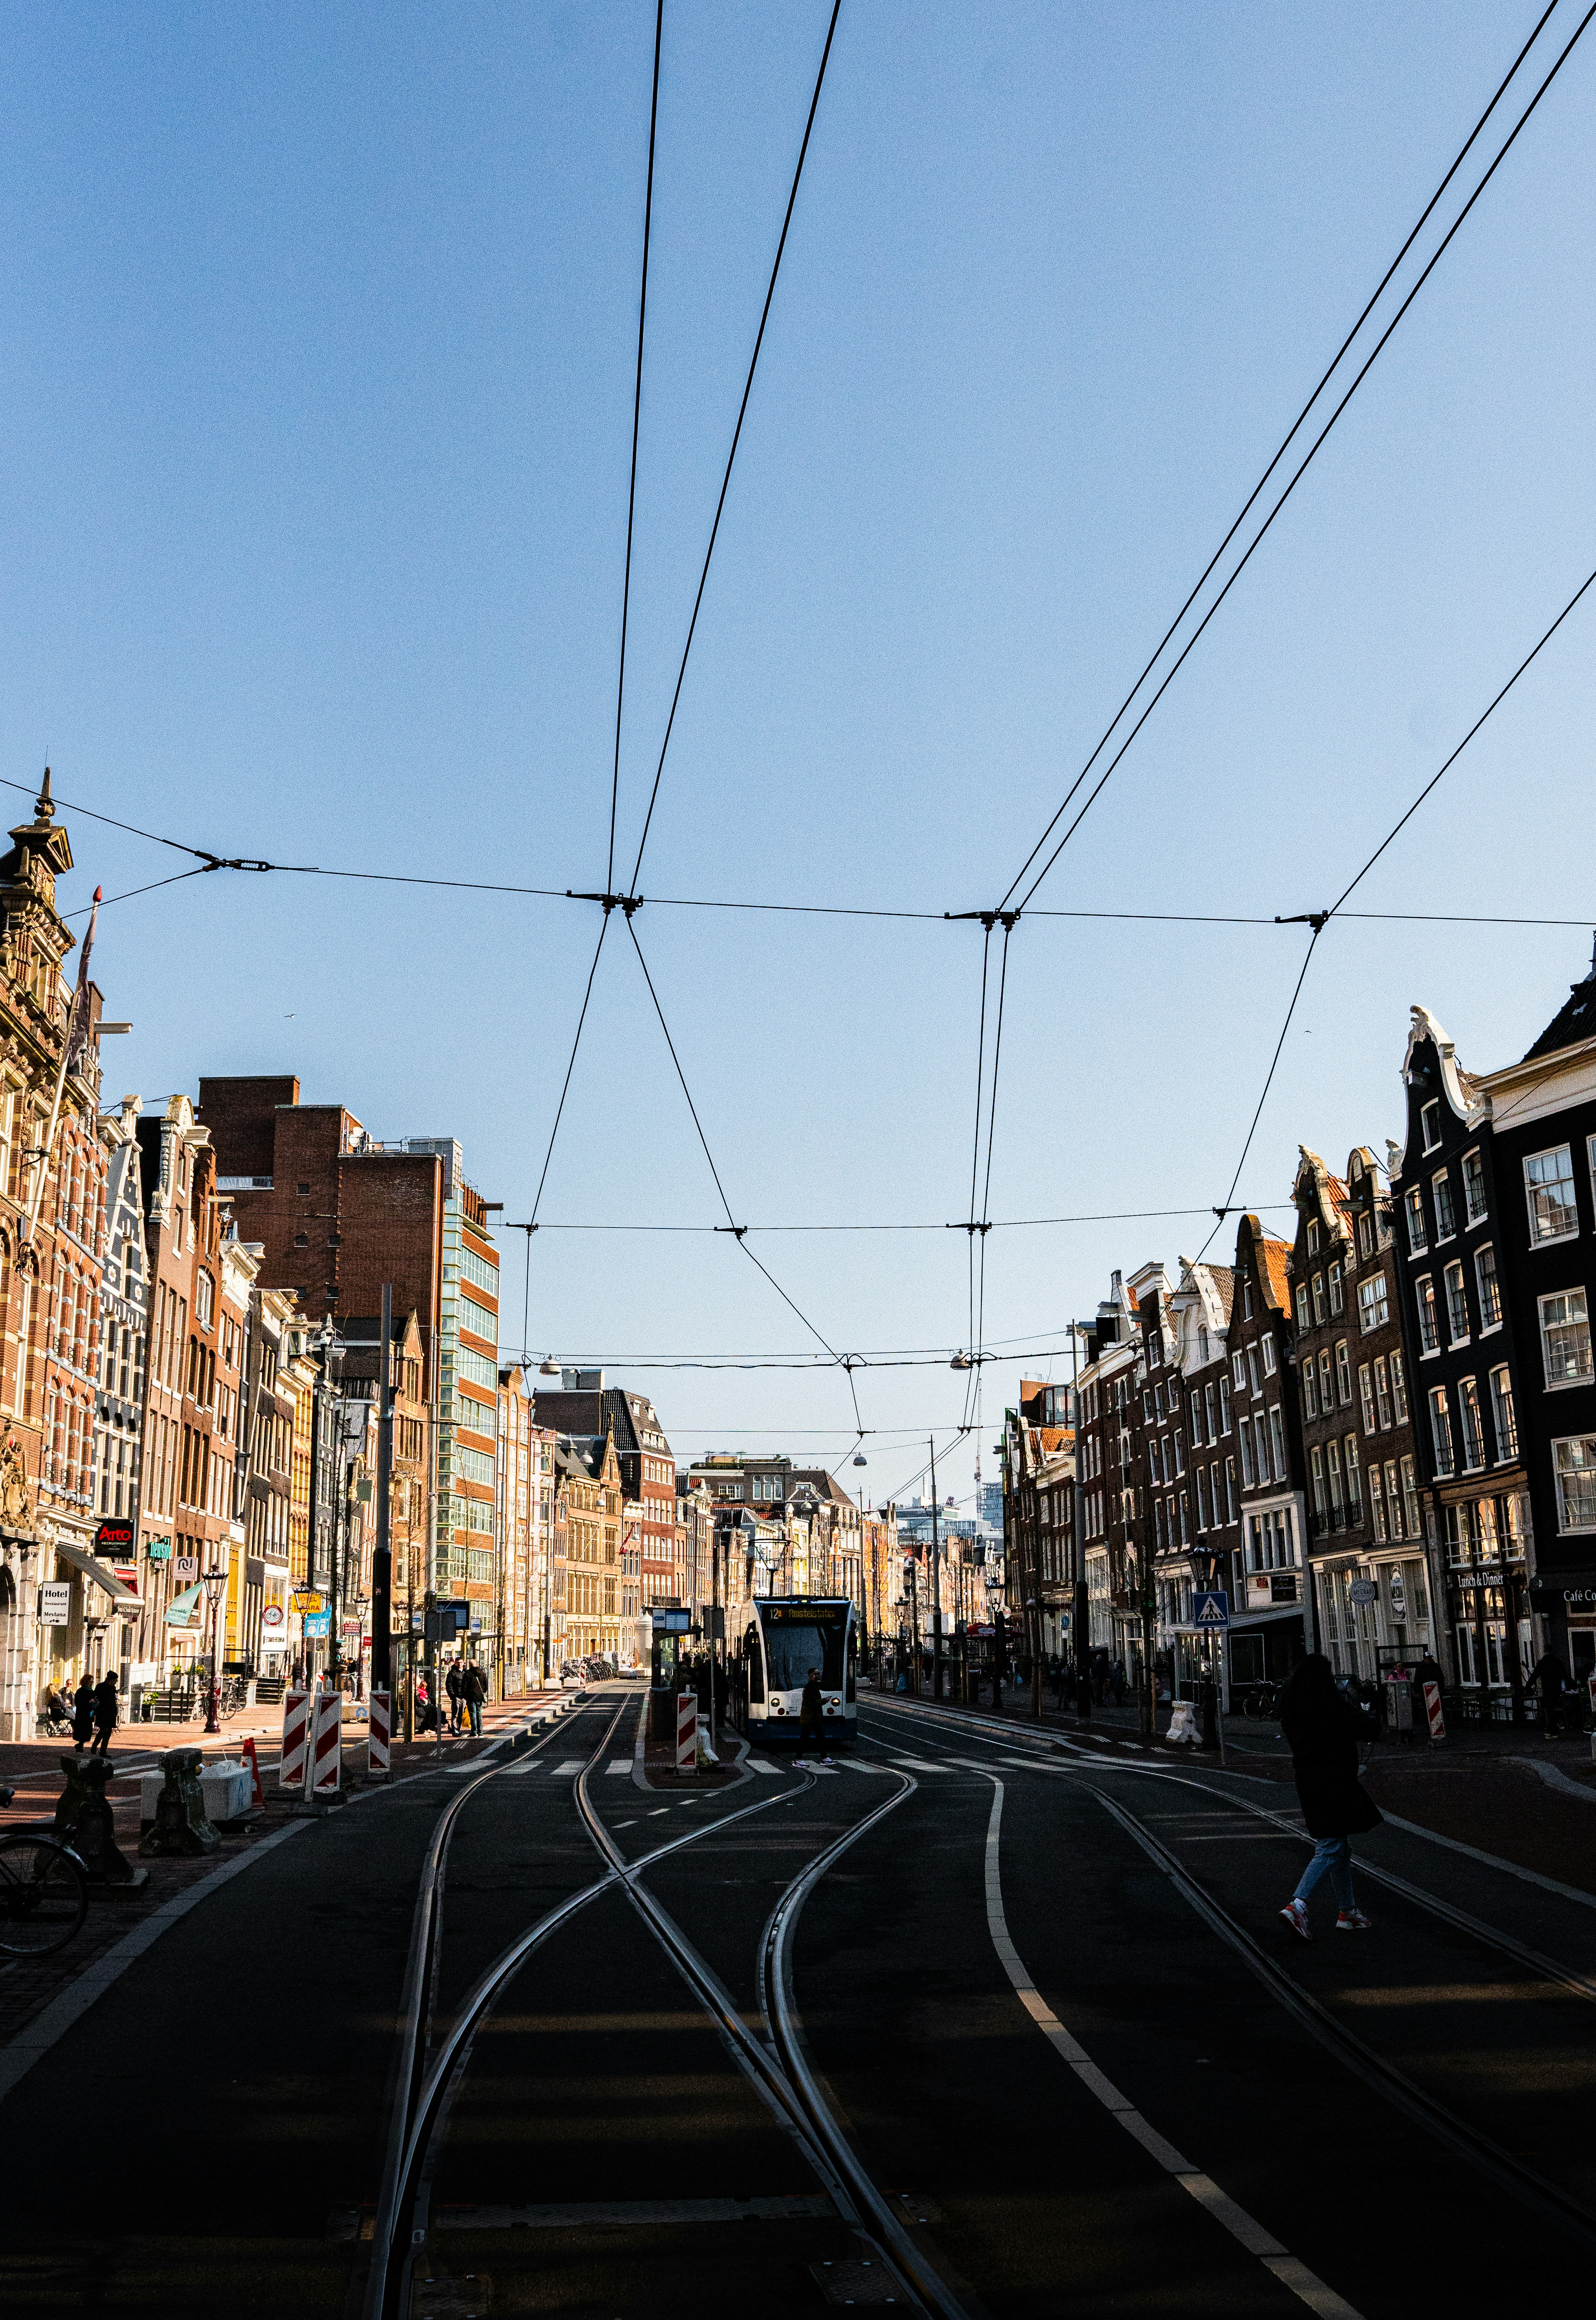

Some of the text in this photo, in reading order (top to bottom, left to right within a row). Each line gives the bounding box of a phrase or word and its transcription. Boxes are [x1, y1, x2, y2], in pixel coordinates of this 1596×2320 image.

[98, 1526, 132, 1541] Arto
[150, 1538, 171, 1559] newside
[1458, 1572, 1503, 1587] Lunch & Dinner
[1563, 1590, 1596, 1601] Café Co
[770, 1608, 779, 1619] 12
